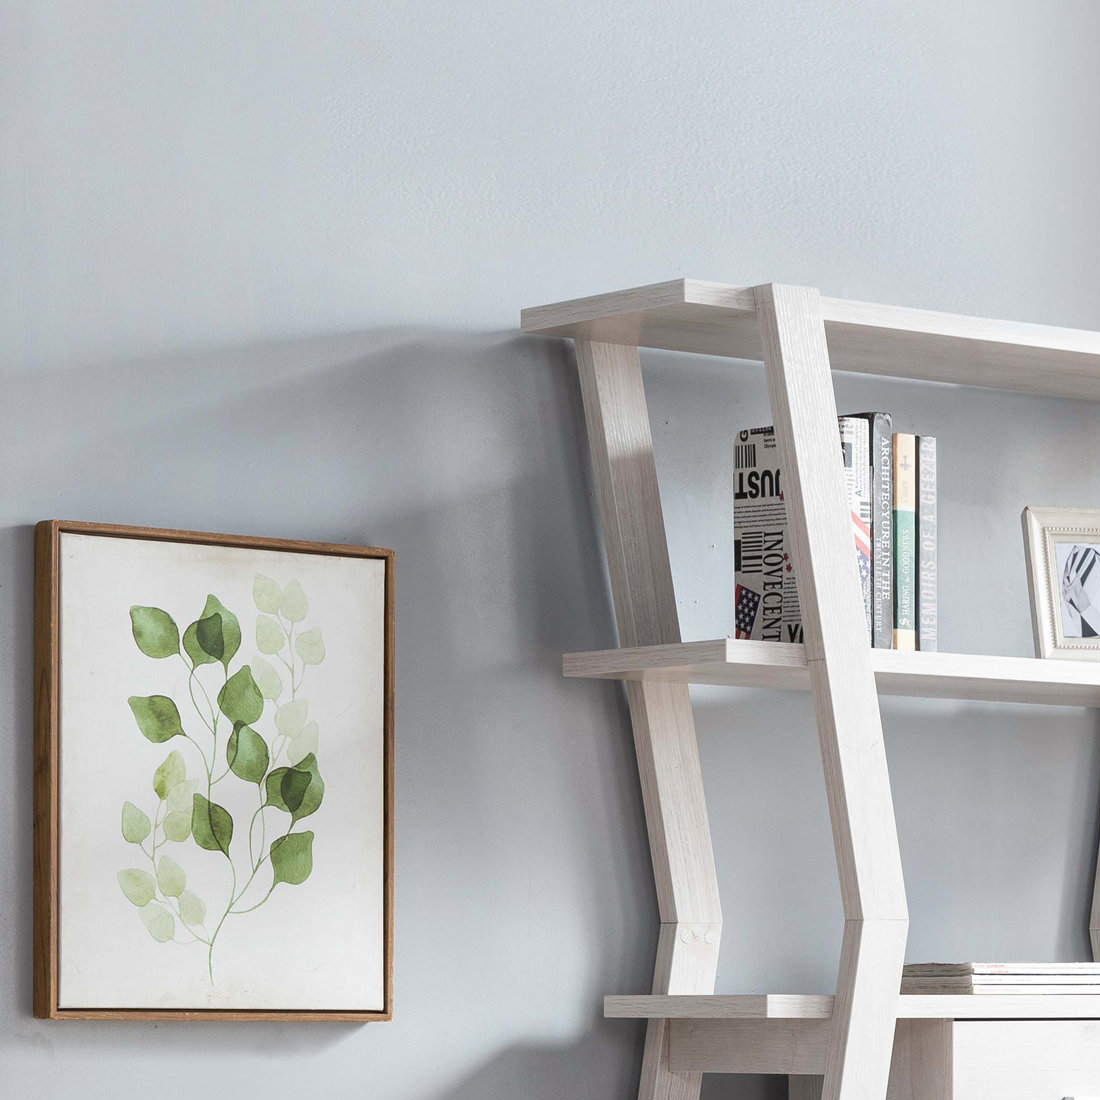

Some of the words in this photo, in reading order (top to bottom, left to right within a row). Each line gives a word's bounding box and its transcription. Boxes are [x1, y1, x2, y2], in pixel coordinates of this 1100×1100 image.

[735, 468, 781, 500] JUST
[921, 441, 936, 504] GEEZER
[881, 436, 891, 548] ARCHITECYURE
[922, 512, 936, 522] A
[902, 528, 911, 551] NEWS
[922, 529, 937, 551] OF
[882, 551, 891, 566] IN
[902, 552, 910, 574] GOOD
[882, 570, 891, 600] THE
[922, 561, 937, 641] MEMOIRS
